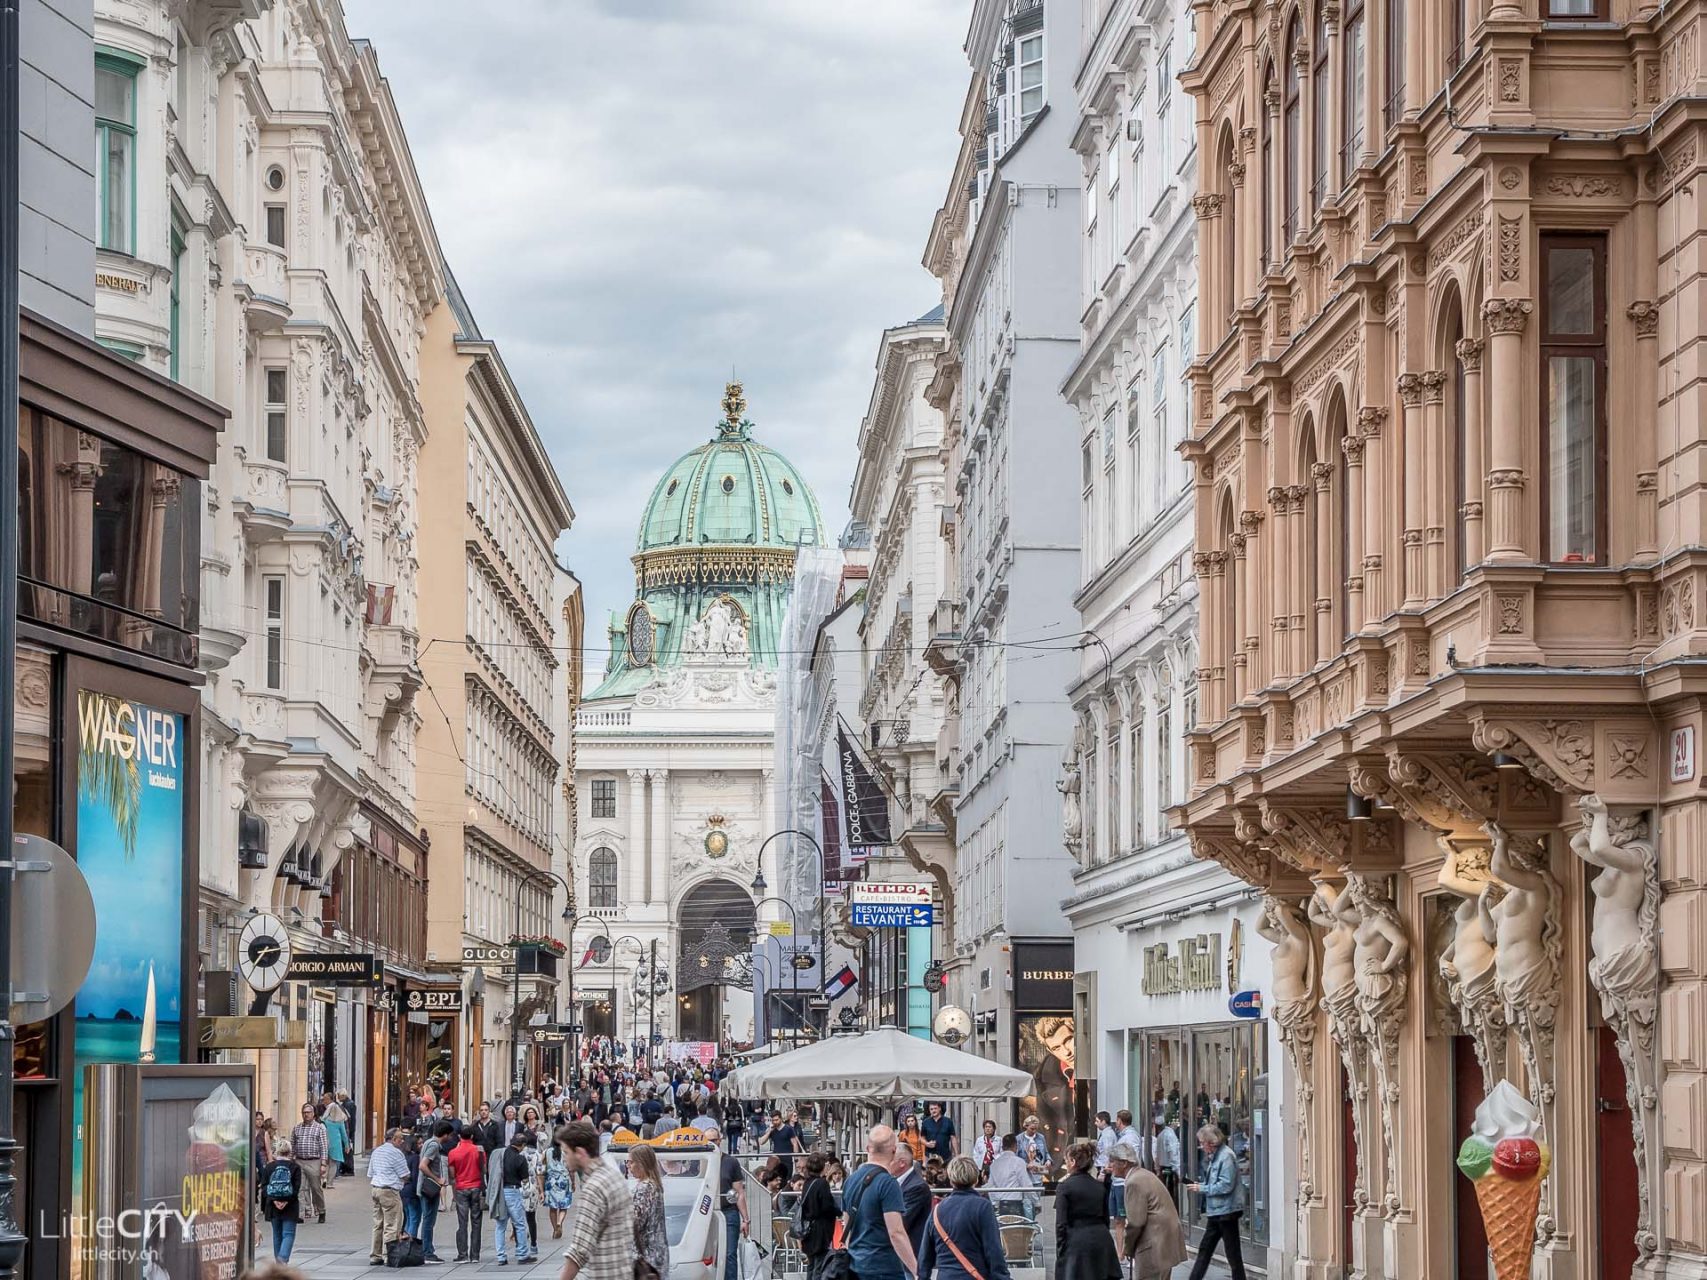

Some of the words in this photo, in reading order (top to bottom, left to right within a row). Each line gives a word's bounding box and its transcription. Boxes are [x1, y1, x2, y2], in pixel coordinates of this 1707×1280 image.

[77, 693, 176, 768] WAGNER
[1675, 731, 1686, 762] 20
[843, 751, 858, 804] GABBANA
[849, 809, 862, 842] DOLCE
[855, 906, 912, 914] RESTAURANT
[855, 914, 912, 925] LEVANTE
[464, 949, 516, 959] GUCCI
[327, 962, 365, 972] ARMANI
[1023, 971, 1074, 980] BURBE
[424, 992, 461, 1006] EPL
[816, 1080, 884, 1091] Julius
[913, 1079, 971, 1089] Meinl
[676, 1134, 704, 1142] FAXI
[182, 1171, 240, 1217] CHAPEAU!
